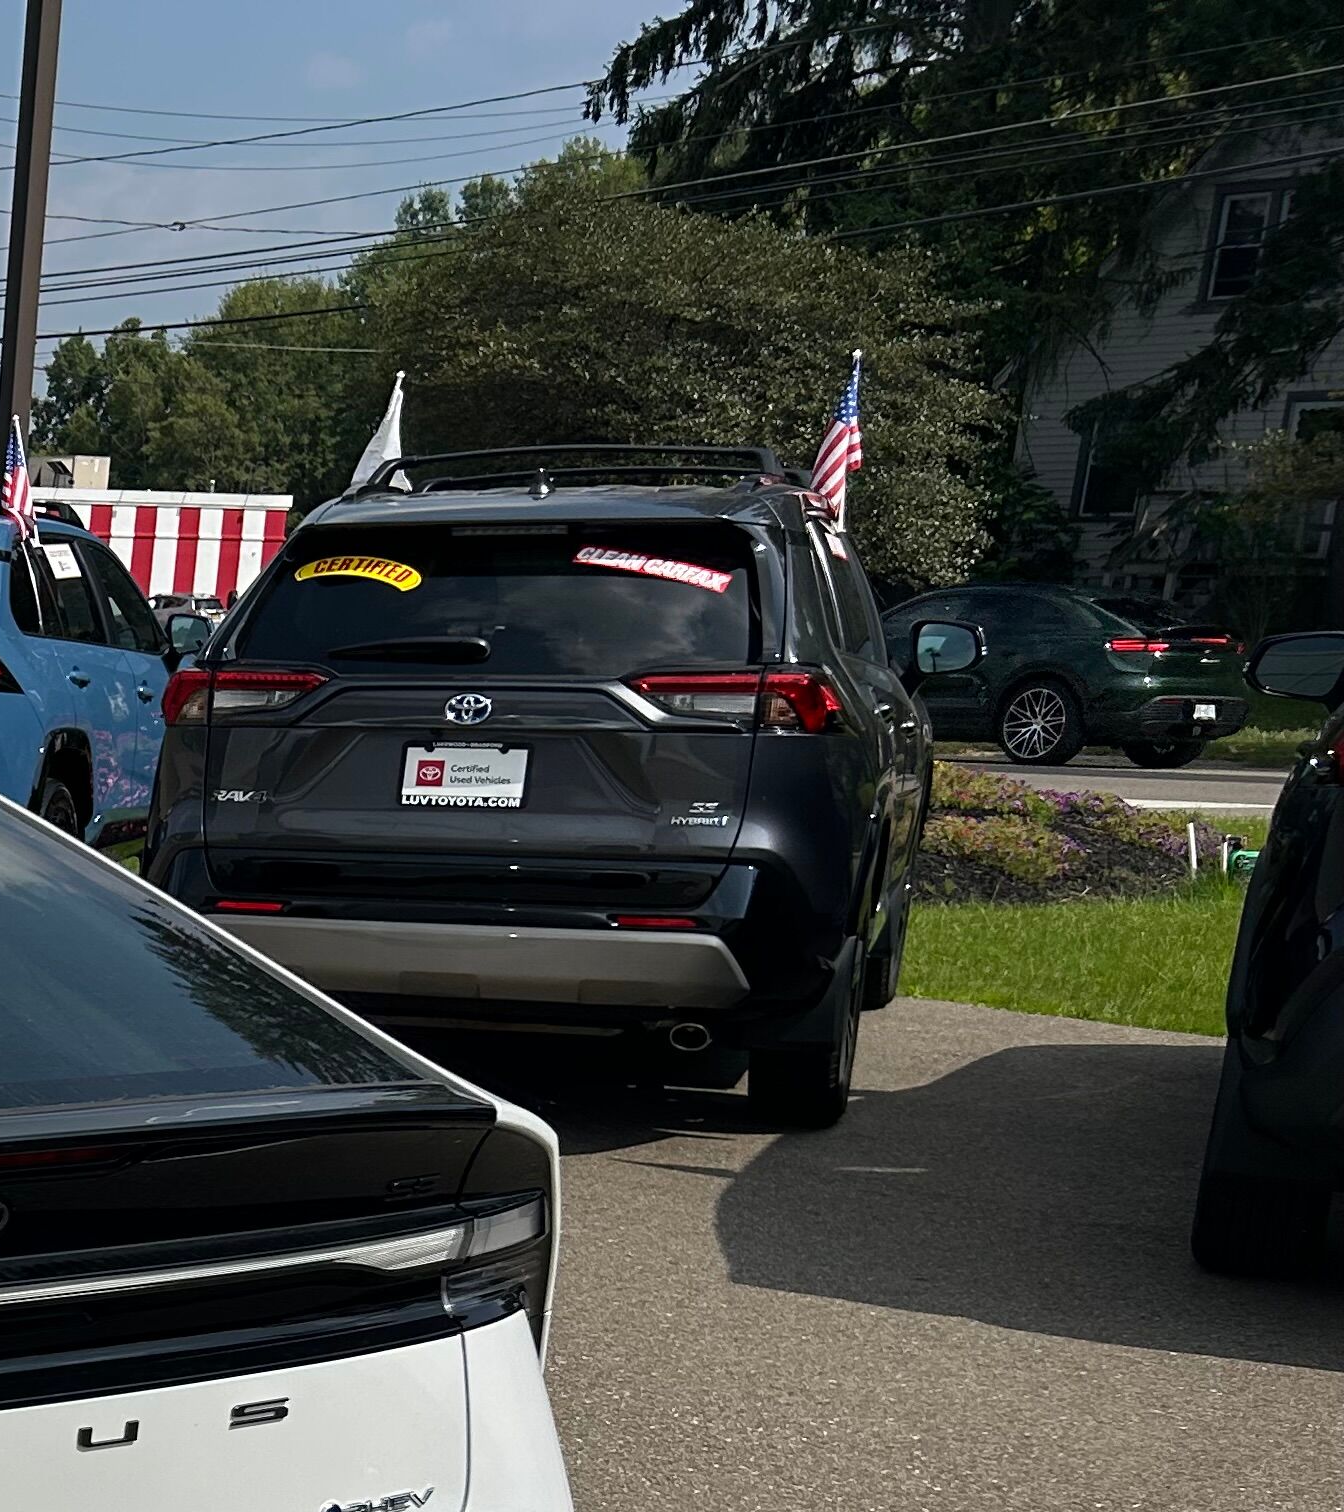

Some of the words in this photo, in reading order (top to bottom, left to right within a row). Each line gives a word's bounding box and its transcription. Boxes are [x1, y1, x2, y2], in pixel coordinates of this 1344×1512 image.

[314, 558, 412, 582] CERTIFIED
[576, 547, 647, 571] CLEAN
[643, 559, 732, 592] CARFAX
[450, 764, 490, 773] Certified
[449, 776, 472, 784] Used
[475, 776, 512, 785] Vehicles
[212, 789, 269, 803] RAV4
[402, 794, 520, 808] LUVTOYOTA.COM
